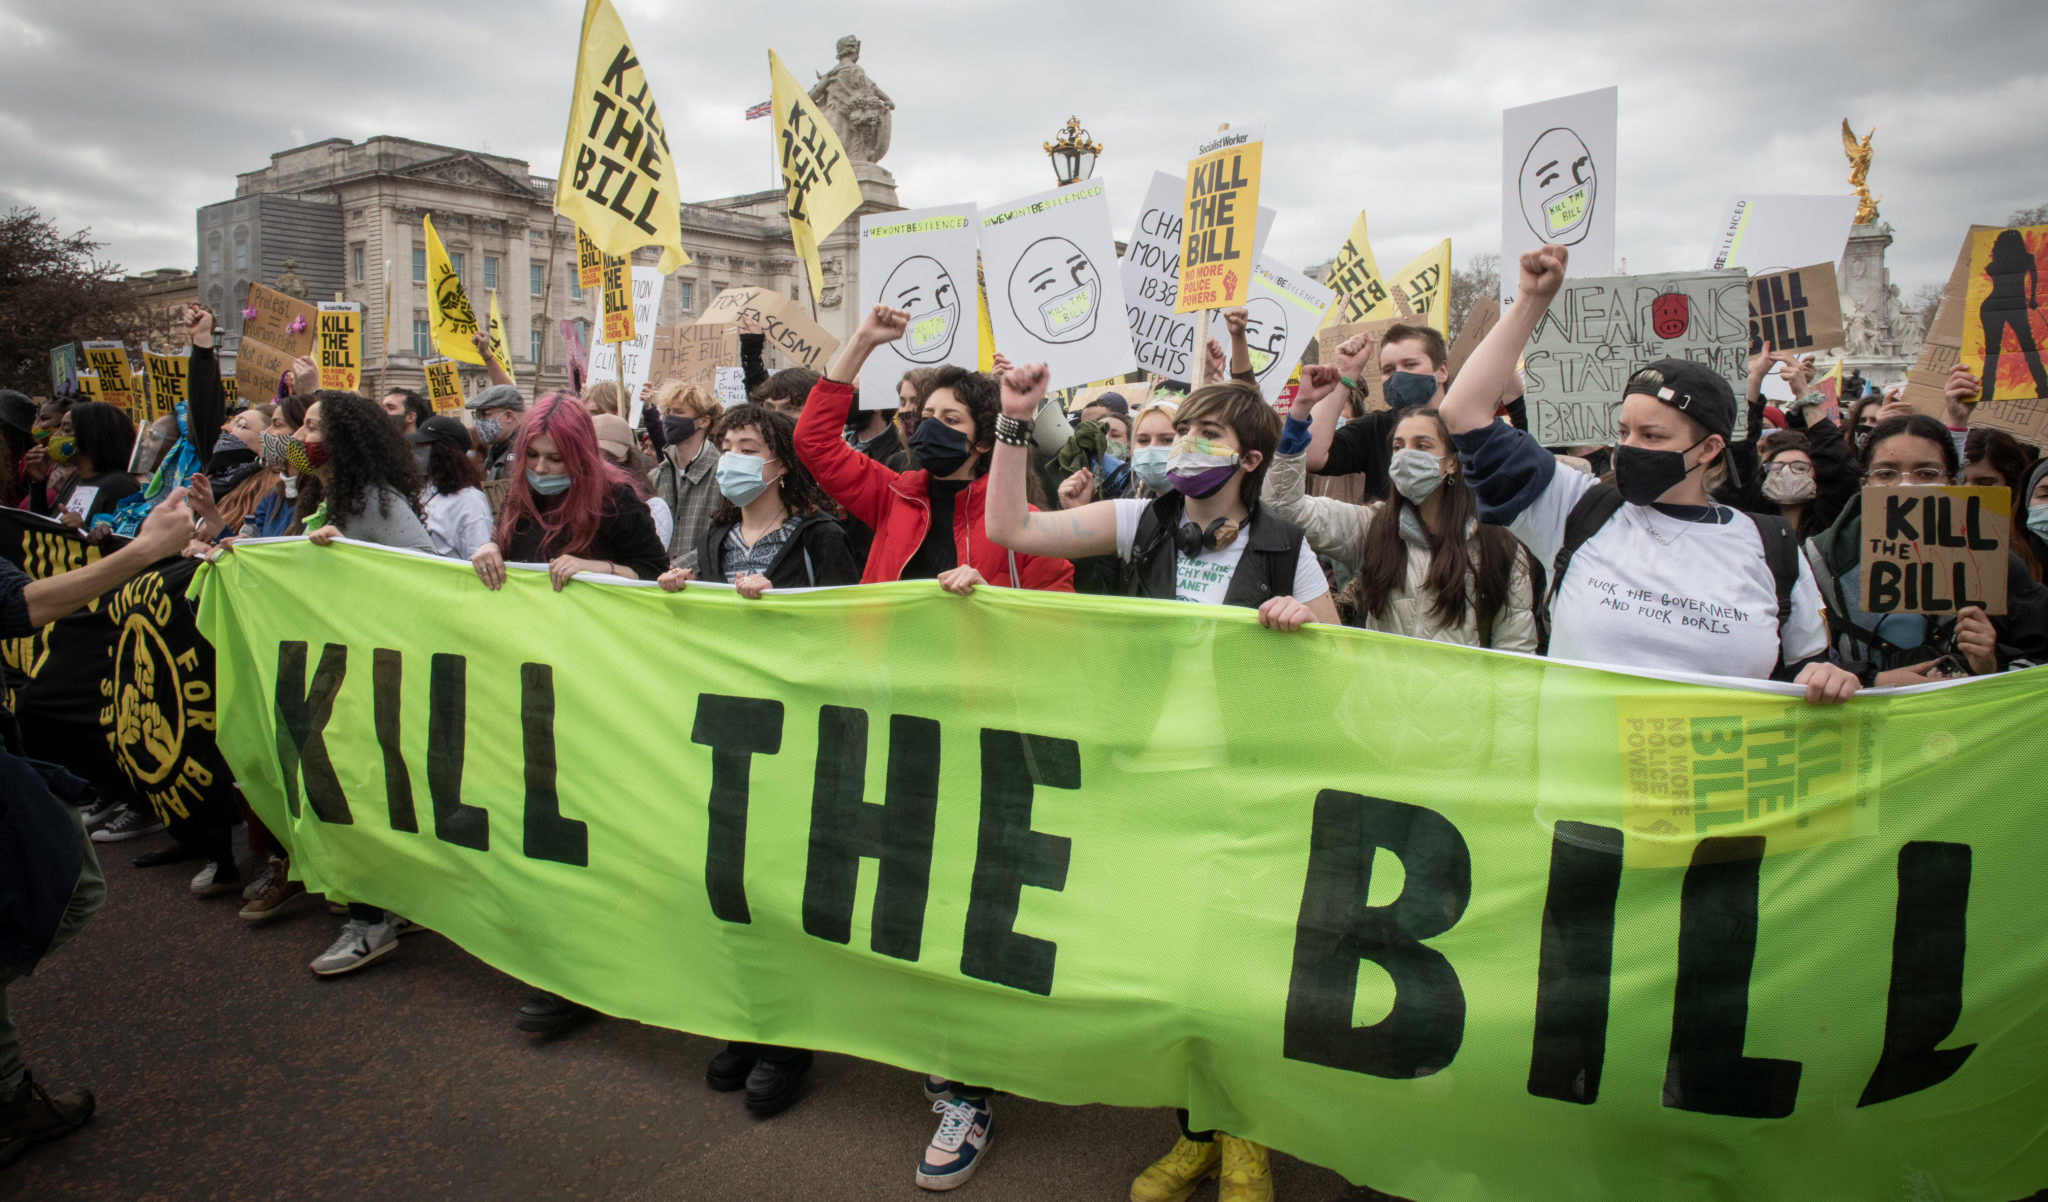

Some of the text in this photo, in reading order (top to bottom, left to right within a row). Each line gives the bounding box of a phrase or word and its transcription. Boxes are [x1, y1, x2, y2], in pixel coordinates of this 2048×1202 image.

[588, 90, 661, 181] THE
[789, 99, 840, 187] KILL
[572, 143, 659, 236] BILL
[1192, 155, 1248, 199] KILL
[1190, 191, 1237, 233] THE
[1549, 190, 1584, 215] KILL THE
[1562, 206, 1581, 221] BILL
[1141, 208, 1182, 244] CHA
[1713, 199, 1747, 271] BESILENCED
[1187, 226, 1240, 268] BILL
[1131, 241, 1180, 280] MOVE
[1185, 264, 1223, 281] NO MORE
[604, 267, 622, 292] THE
[632, 279, 653, 299] TION
[1184, 278, 1210, 294] POLICE
[1255, 264, 1325, 309] EWONTBESILENCED
[254, 288, 290, 319] Protest
[605, 290, 628, 314] BILL
[713, 291, 760, 310] TORY
[1182, 291, 1216, 307] POWERS
[322, 316, 354, 333] KILL
[1126, 303, 1194, 352] OLITICA
[1750, 310, 1813, 355] BILL
[321, 334, 348, 350] THE
[736, 307, 822, 370] FASCISM!
[1595, 342, 1664, 360] OF THE
[90, 352, 122, 365] KILL
[322, 351, 354, 367] BILL
[656, 340, 732, 365] THE BILL
[95, 365, 121, 379] THE
[149, 358, 186, 378] KILL
[428, 365, 454, 378] KILL
[101, 379, 130, 391] BILL
[152, 375, 182, 395] THE
[1885, 495, 1998, 551] KILL
[1870, 538, 1910, 560] THE
[1177, 557, 1230, 573] STROY THE
[1202, 571, 1224, 584] NOT
[108, 570, 172, 627] UNITED
[1588, 577, 1618, 595] FUCK
[1868, 560, 1987, 614] BILL
[1600, 597, 1730, 634] AND FUCK BORIS
[176, 647, 216, 732] FOR
[1690, 716, 1744, 836] BILL
[1797, 719, 1843, 829] KIL
[274, 640, 1979, 1118] KILL THE BILL
